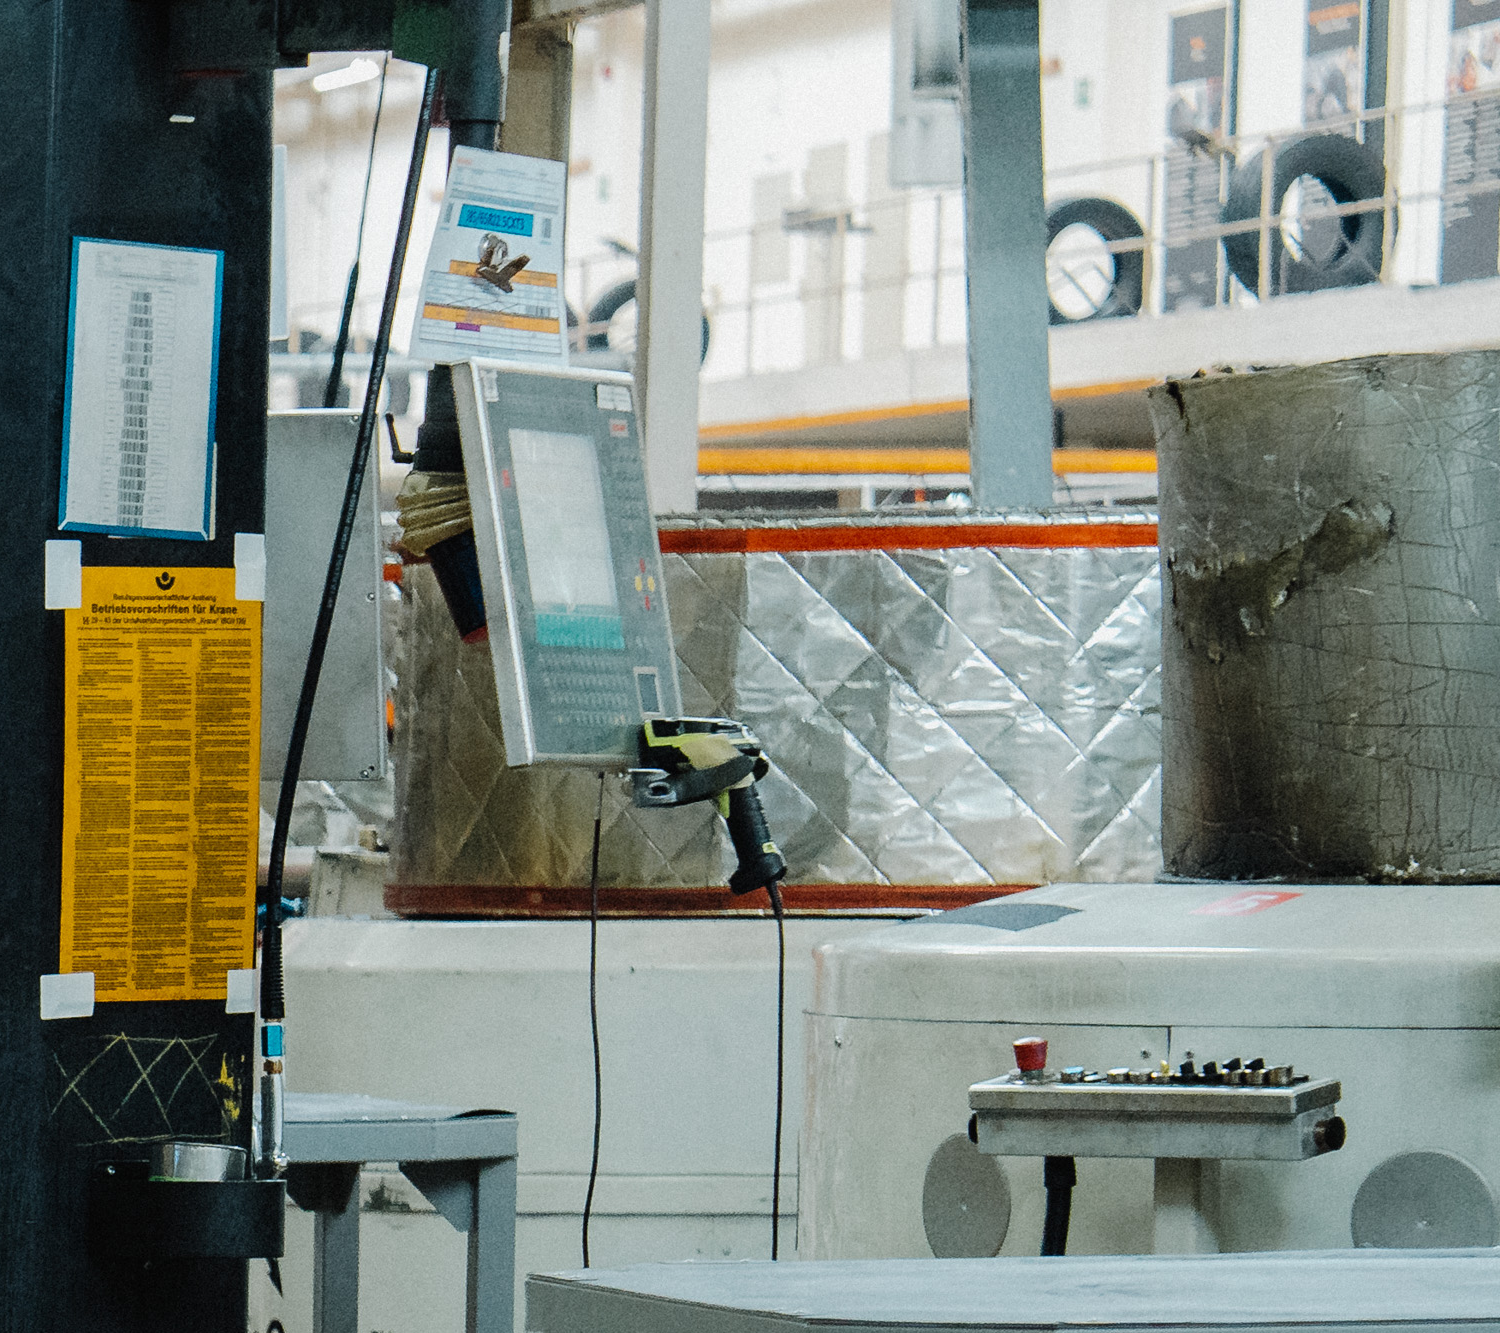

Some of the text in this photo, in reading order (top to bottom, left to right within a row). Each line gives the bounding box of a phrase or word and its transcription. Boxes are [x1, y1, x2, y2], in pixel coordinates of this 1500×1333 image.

[91, 603, 238, 614] Betriebsvorschriften für Krane
